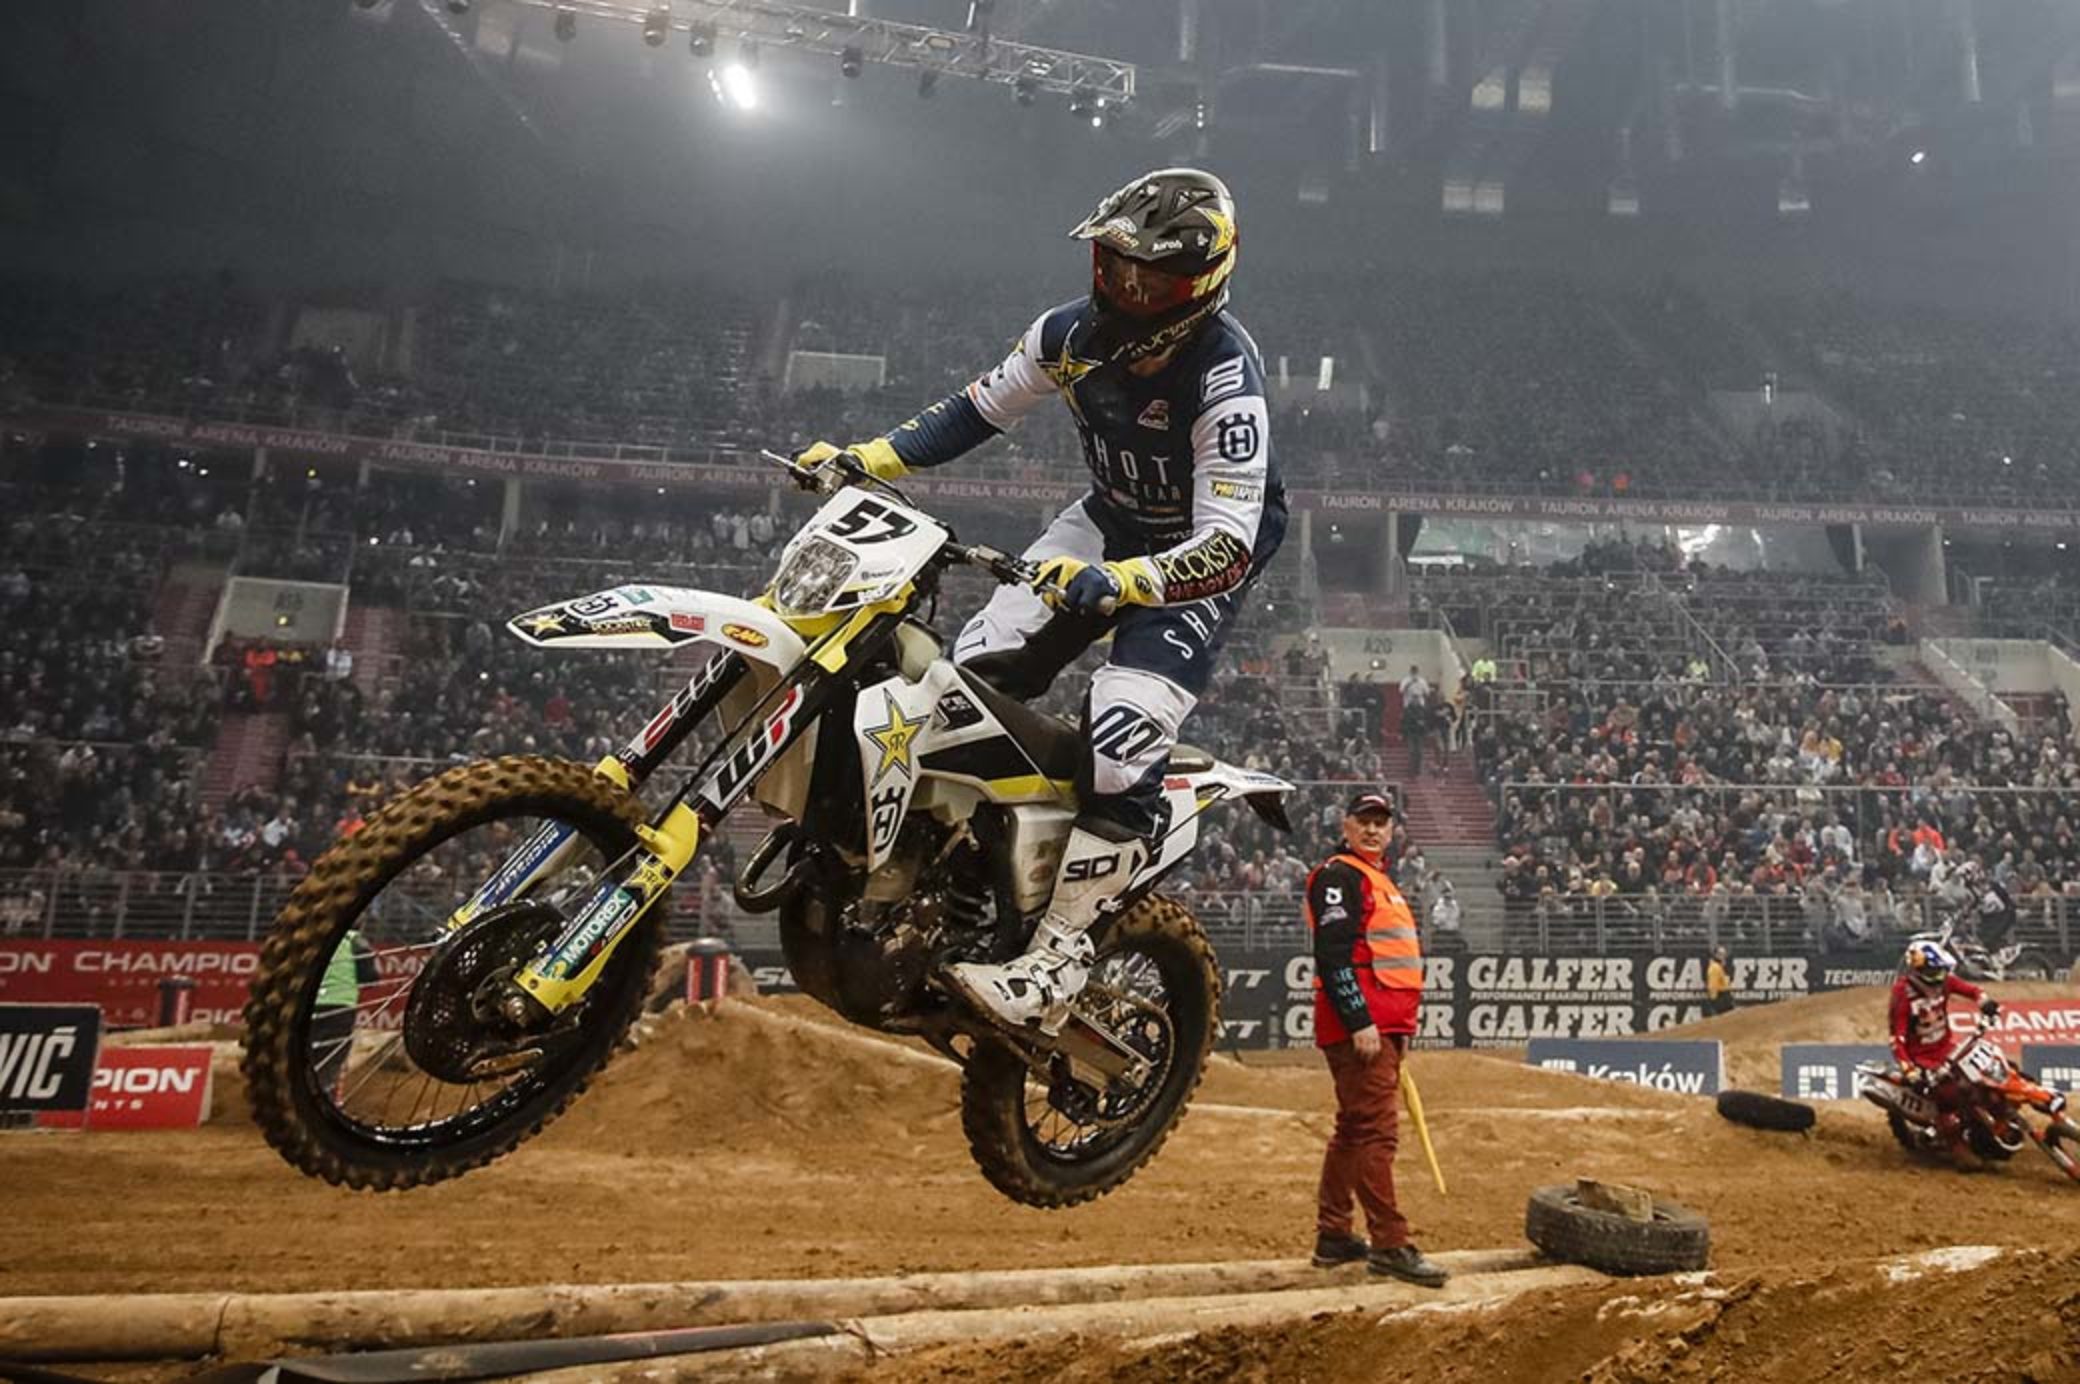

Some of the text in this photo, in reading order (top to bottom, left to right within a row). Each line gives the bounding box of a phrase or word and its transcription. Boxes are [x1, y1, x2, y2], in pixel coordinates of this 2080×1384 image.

[459, 453, 517, 472] ARENA
[937, 482, 992, 497] ARENA
[1321, 495, 1382, 509] TAURON
[1387, 496, 1441, 511] ARENA
[1540, 501, 1599, 515] TAURON
[1605, 503, 1657, 516] ARENA
[1754, 507, 1813, 521] TAURON
[1818, 508, 1868, 522] ARENA
[828, 497, 918, 545] 57
[563, 888, 628, 964] MOTOREX
[73, 951, 260, 974] CHAMPIO
[1467, 956, 1633, 991] GALFER
[1646, 956, 1809, 991] GAFER
[1468, 1004, 1634, 1038] GALFER
